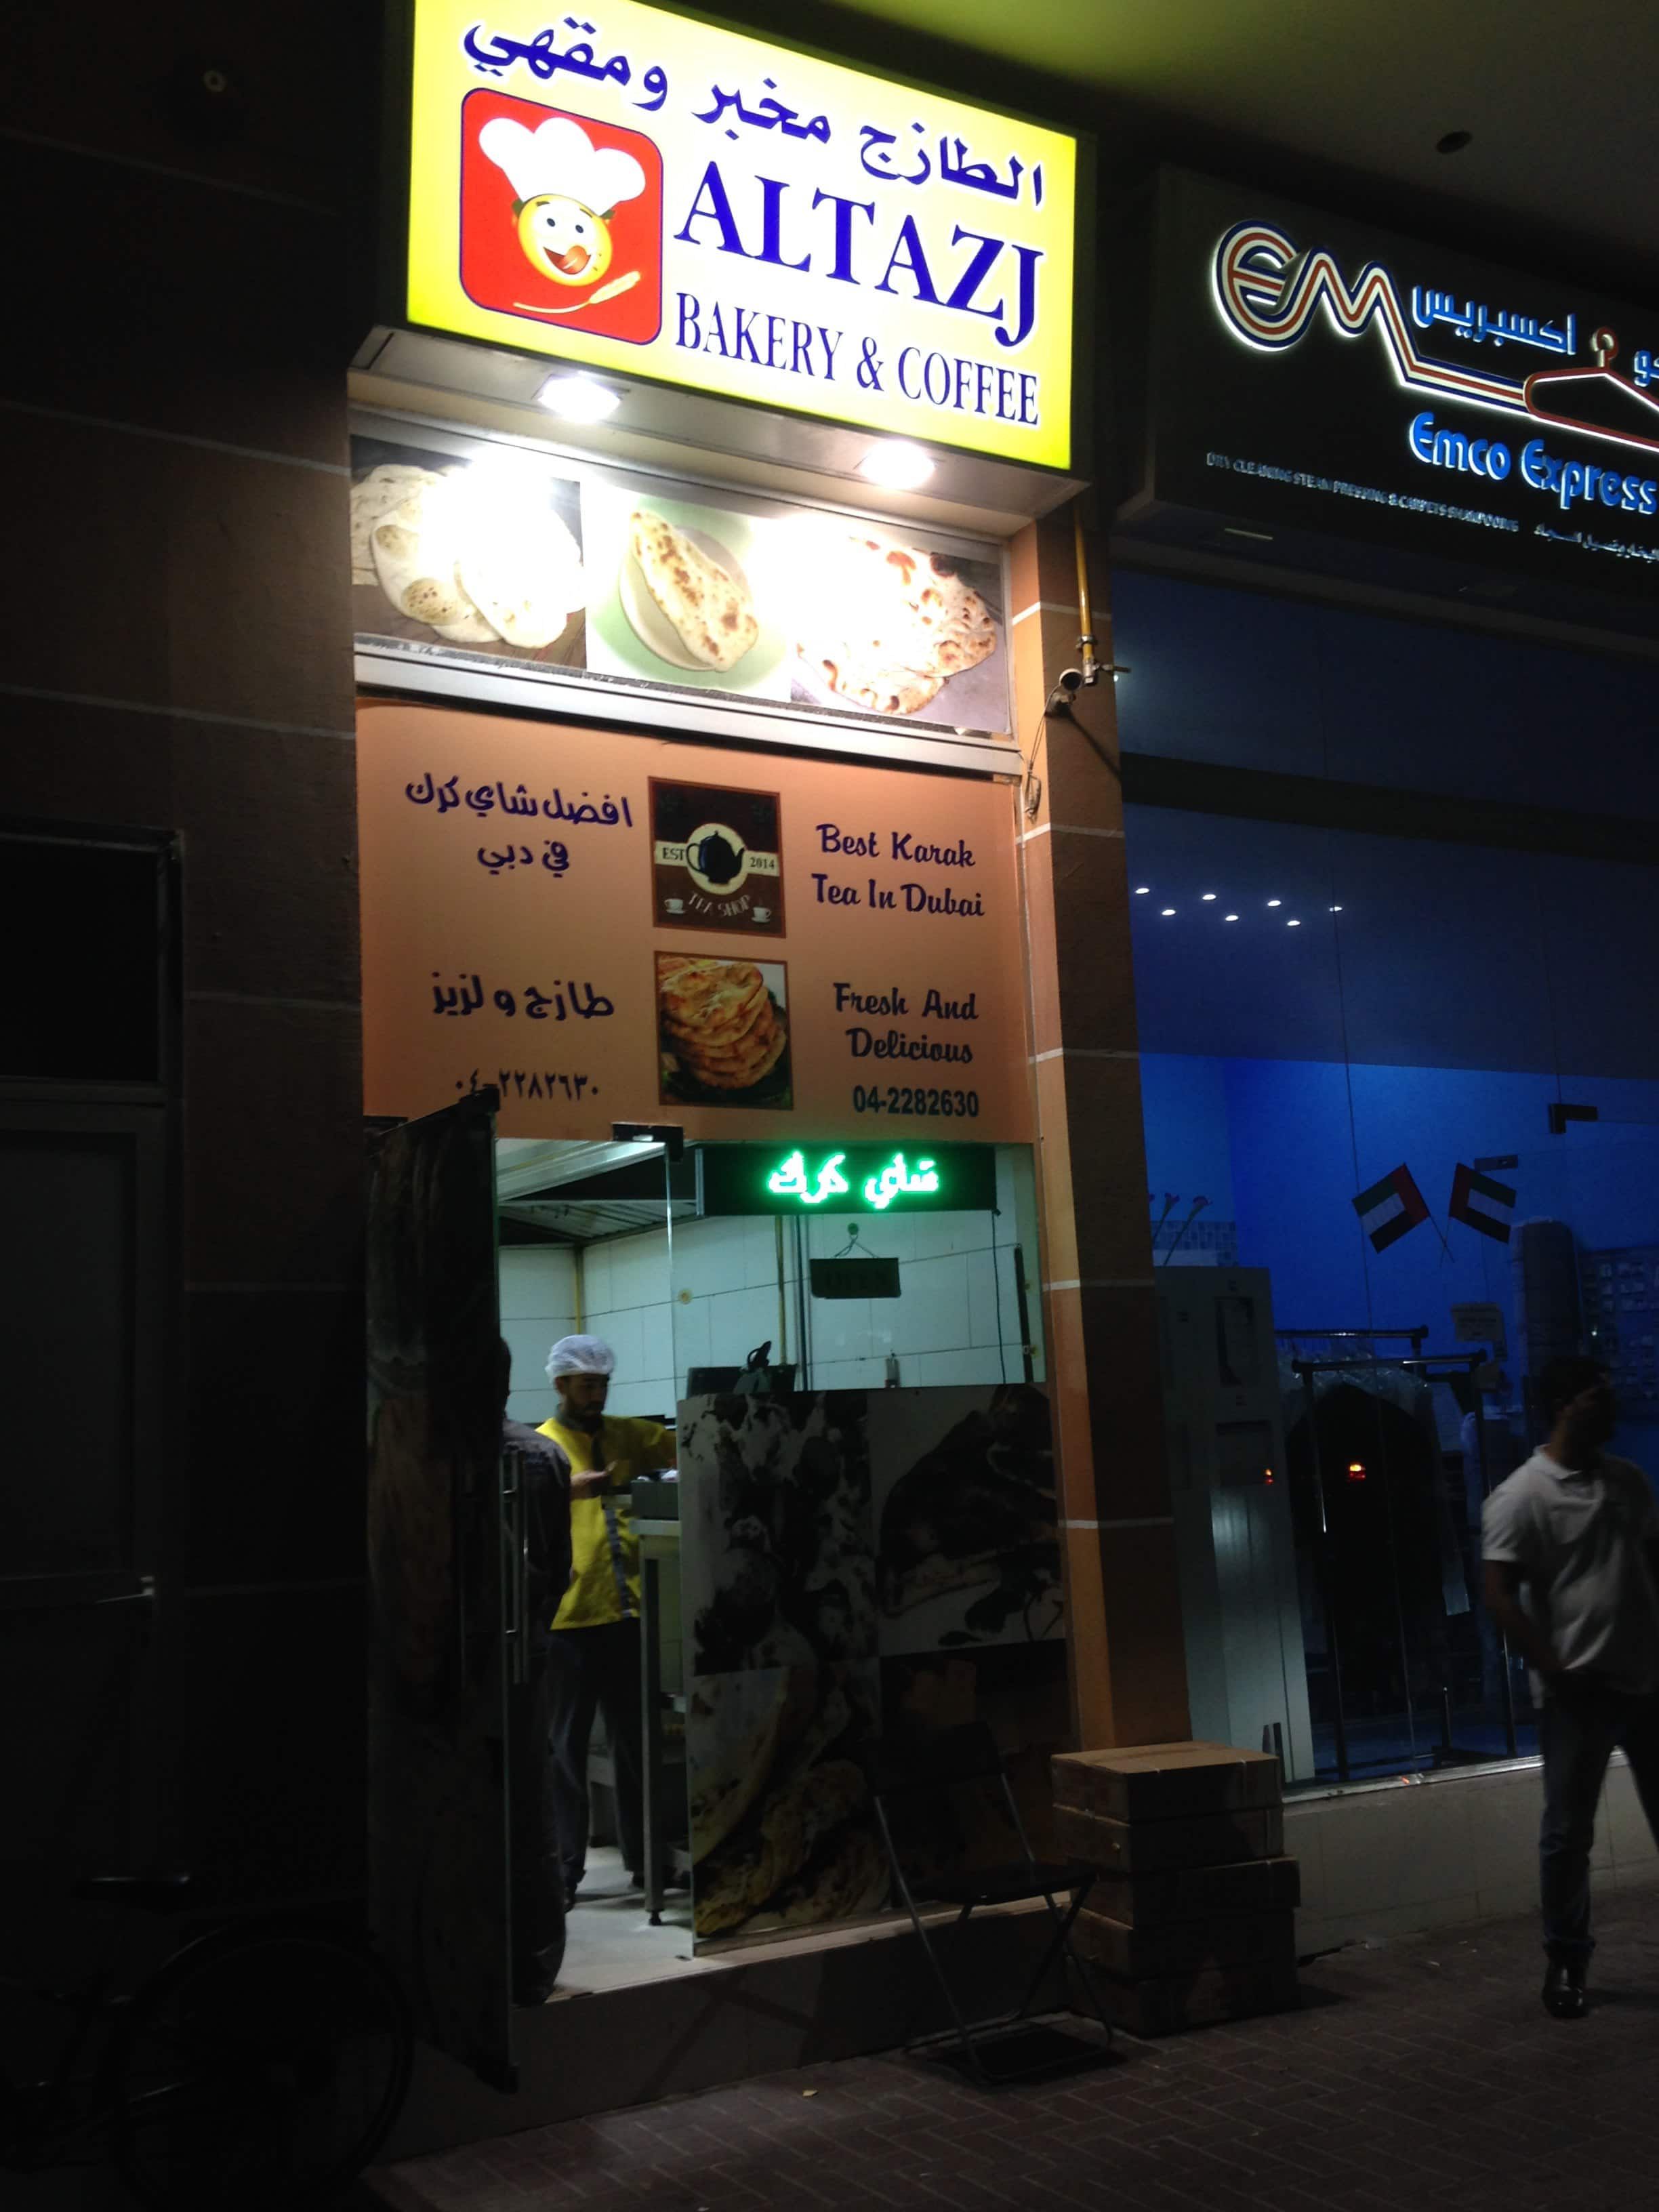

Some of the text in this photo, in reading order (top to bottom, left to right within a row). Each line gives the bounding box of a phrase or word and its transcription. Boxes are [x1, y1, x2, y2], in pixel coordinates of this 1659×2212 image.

[692, 78, 831, 144] مخبر
[859, 123, 1044, 203] الطازج
[674, 161, 1044, 348] ALTAZJ
[1412, 285, 1578, 356] اكسبريس
[676, 291, 1040, 425] BAKERY & COFFEE
[1410, 411, 1658, 516] Emco Express
[405, 772, 633, 828] افضل شاي كرك
[477, 840, 569, 878] في دبي
[662, 846, 684, 861] EST
[750, 857, 775, 870] 2014
[816, 823, 976, 868] Best Karak
[717, 893, 751, 918] SHOP
[811, 873, 985, 917] Tea In Dubai
[431, 971, 614, 1020] طازج و لزيز
[833, 983, 978, 1021] Fresh And
[845, 1027, 974, 1064] Delicious
[852, 1085, 979, 1118] 04-2282630
